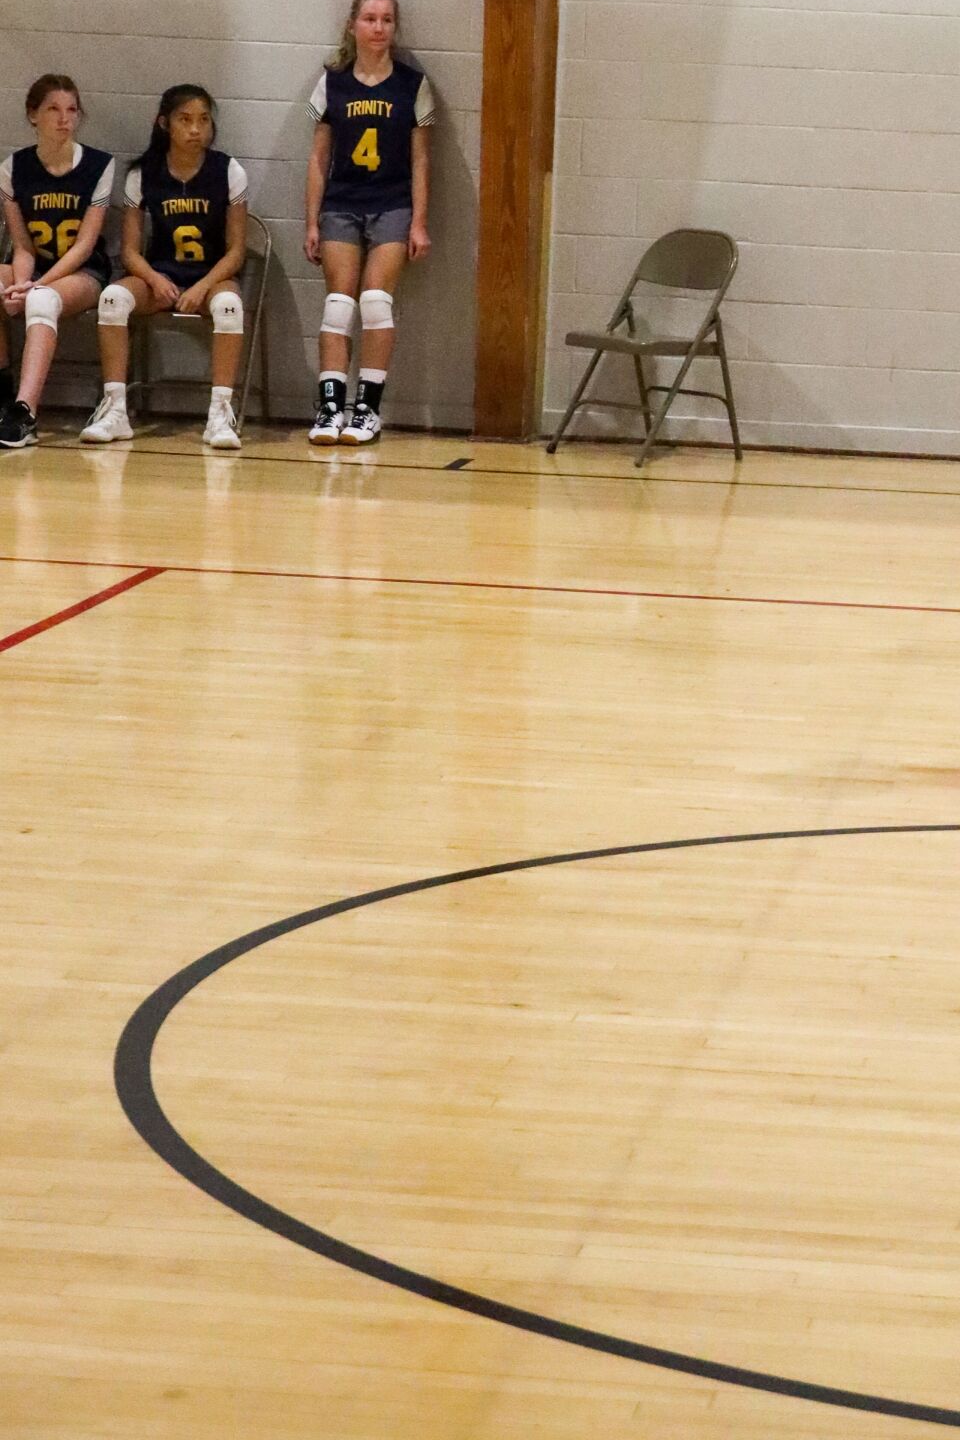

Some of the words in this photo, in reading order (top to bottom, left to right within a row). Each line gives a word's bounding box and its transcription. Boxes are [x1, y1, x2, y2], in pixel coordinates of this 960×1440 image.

[345, 100, 393, 118] TRINITY
[351, 128, 381, 171] 4
[32, 192, 80, 211] TRINITY
[161, 198, 210, 216] TRINITY
[173, 225, 204, 262] 6
